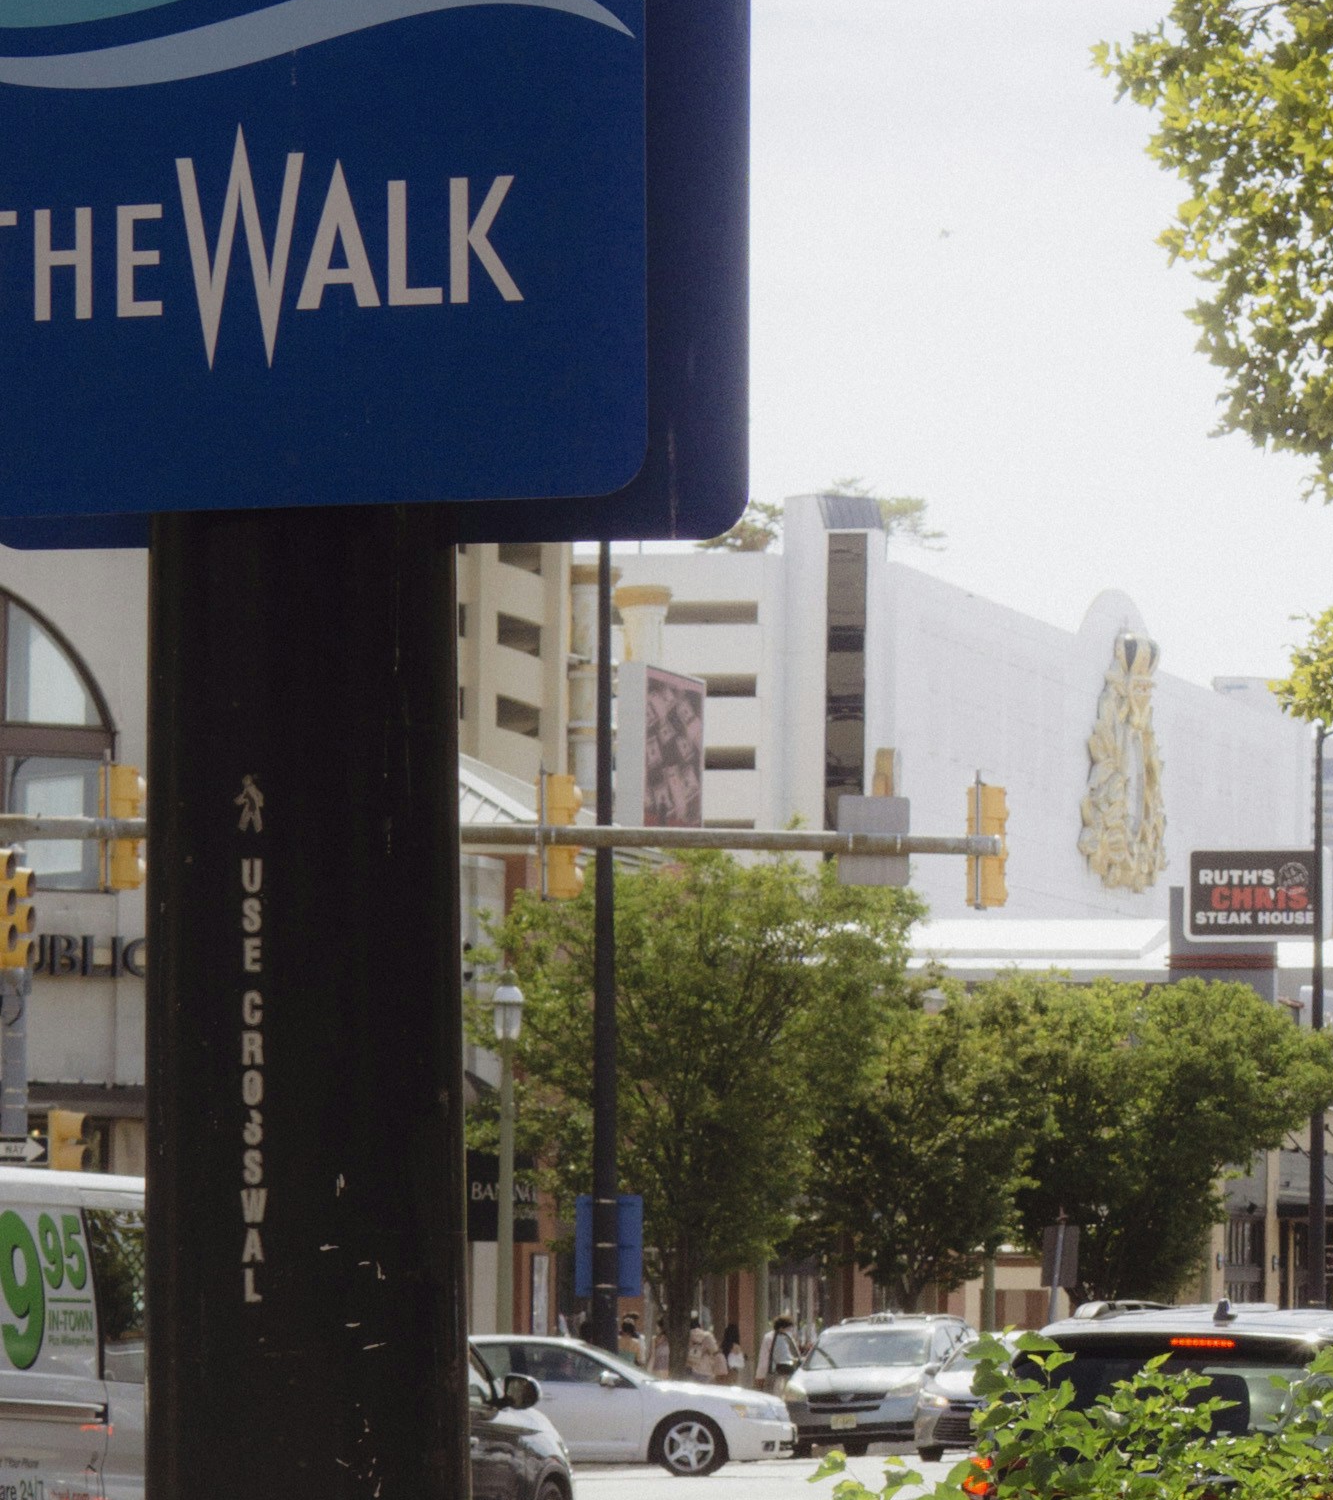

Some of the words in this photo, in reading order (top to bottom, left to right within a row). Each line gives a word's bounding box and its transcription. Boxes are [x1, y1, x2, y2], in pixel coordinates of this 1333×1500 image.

[175, 121, 525, 372] WALK
[1198, 868, 1276, 886] RUTH'S
[1210, 885, 1309, 911] CHRIS
[240, 857, 263, 973] USE
[1195, 911, 1253, 925] STEAK
[1257, 911, 1315, 925] HOUSE
[47, 1310, 93, 1332] IN-TOWN
